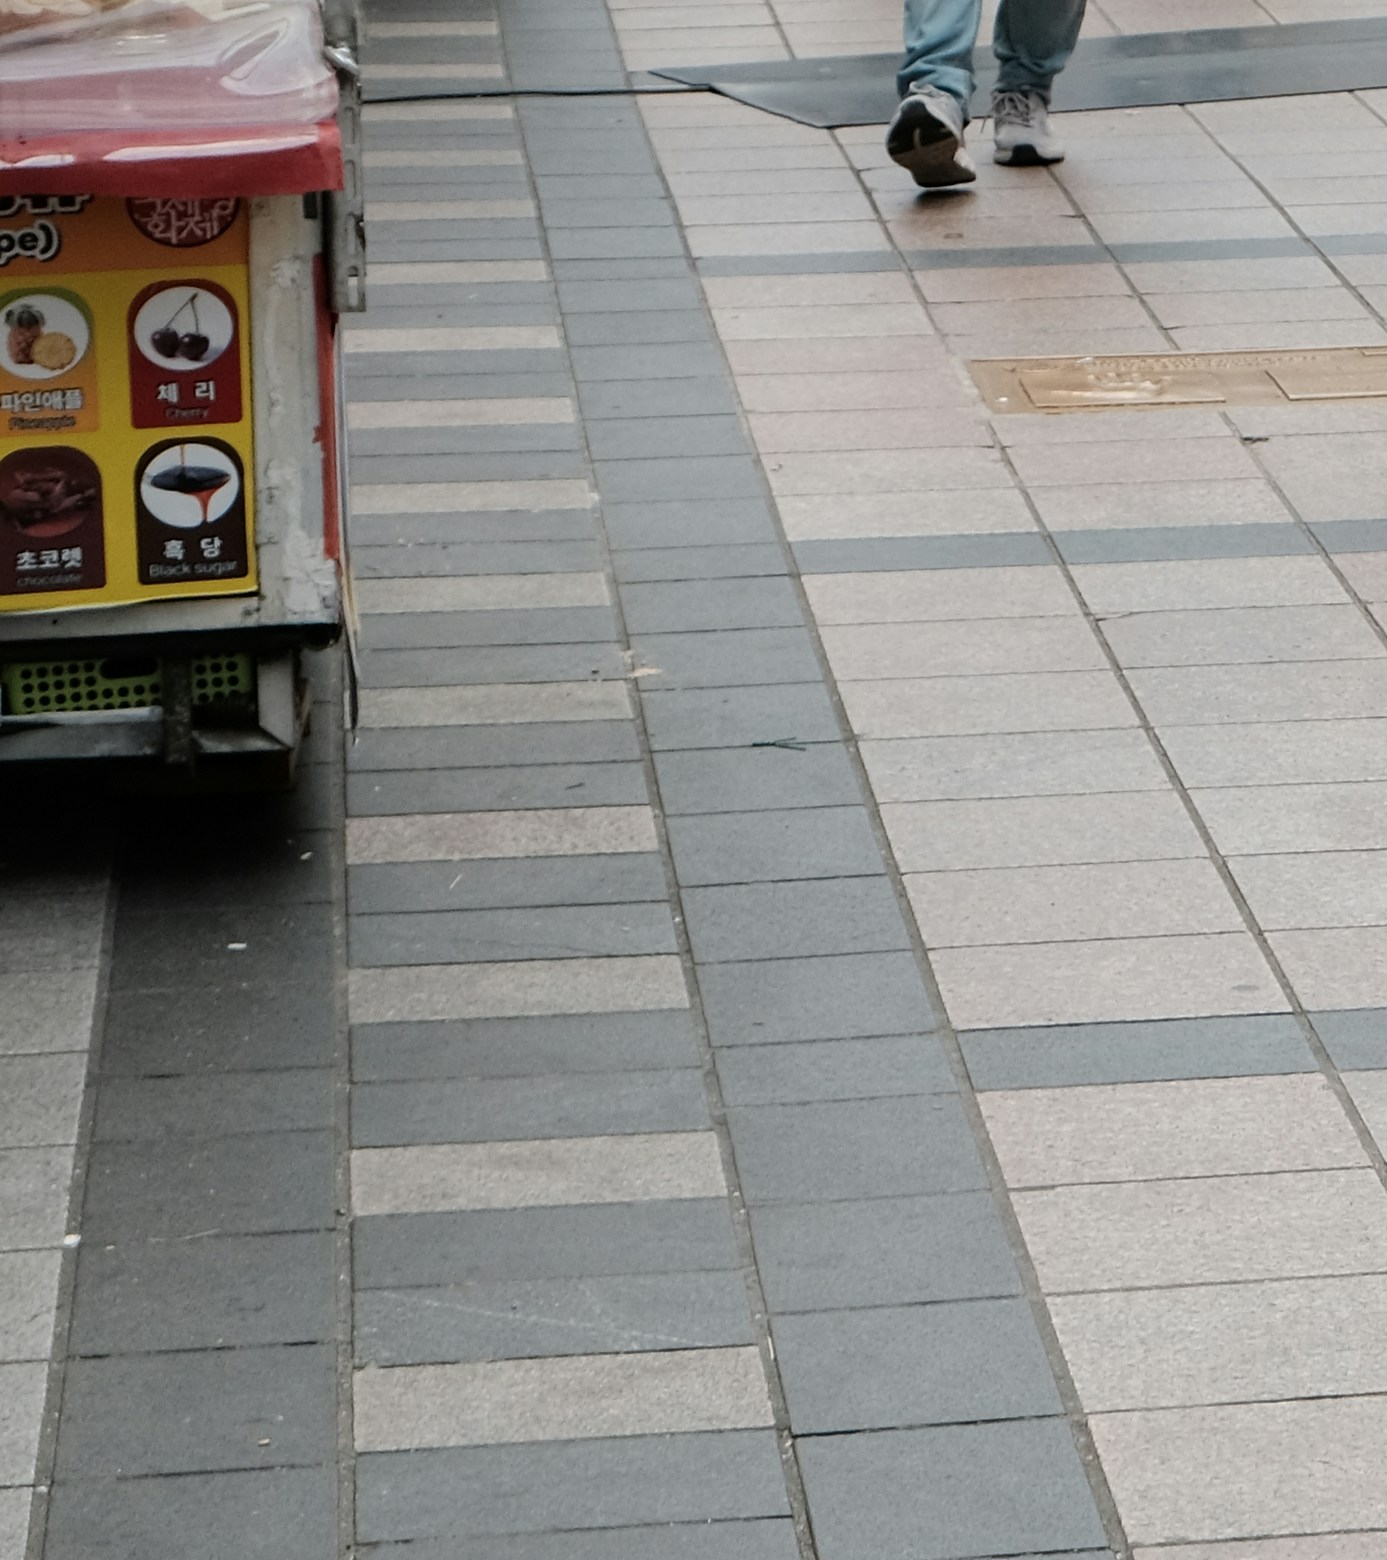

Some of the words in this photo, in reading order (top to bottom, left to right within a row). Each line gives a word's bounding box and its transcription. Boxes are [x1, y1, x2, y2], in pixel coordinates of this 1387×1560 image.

[0, 388, 84, 412] 파인애플
[15, 545, 84, 571] 초코렛
[149, 561, 192, 578] Black
[194, 559, 239, 577] sugar
